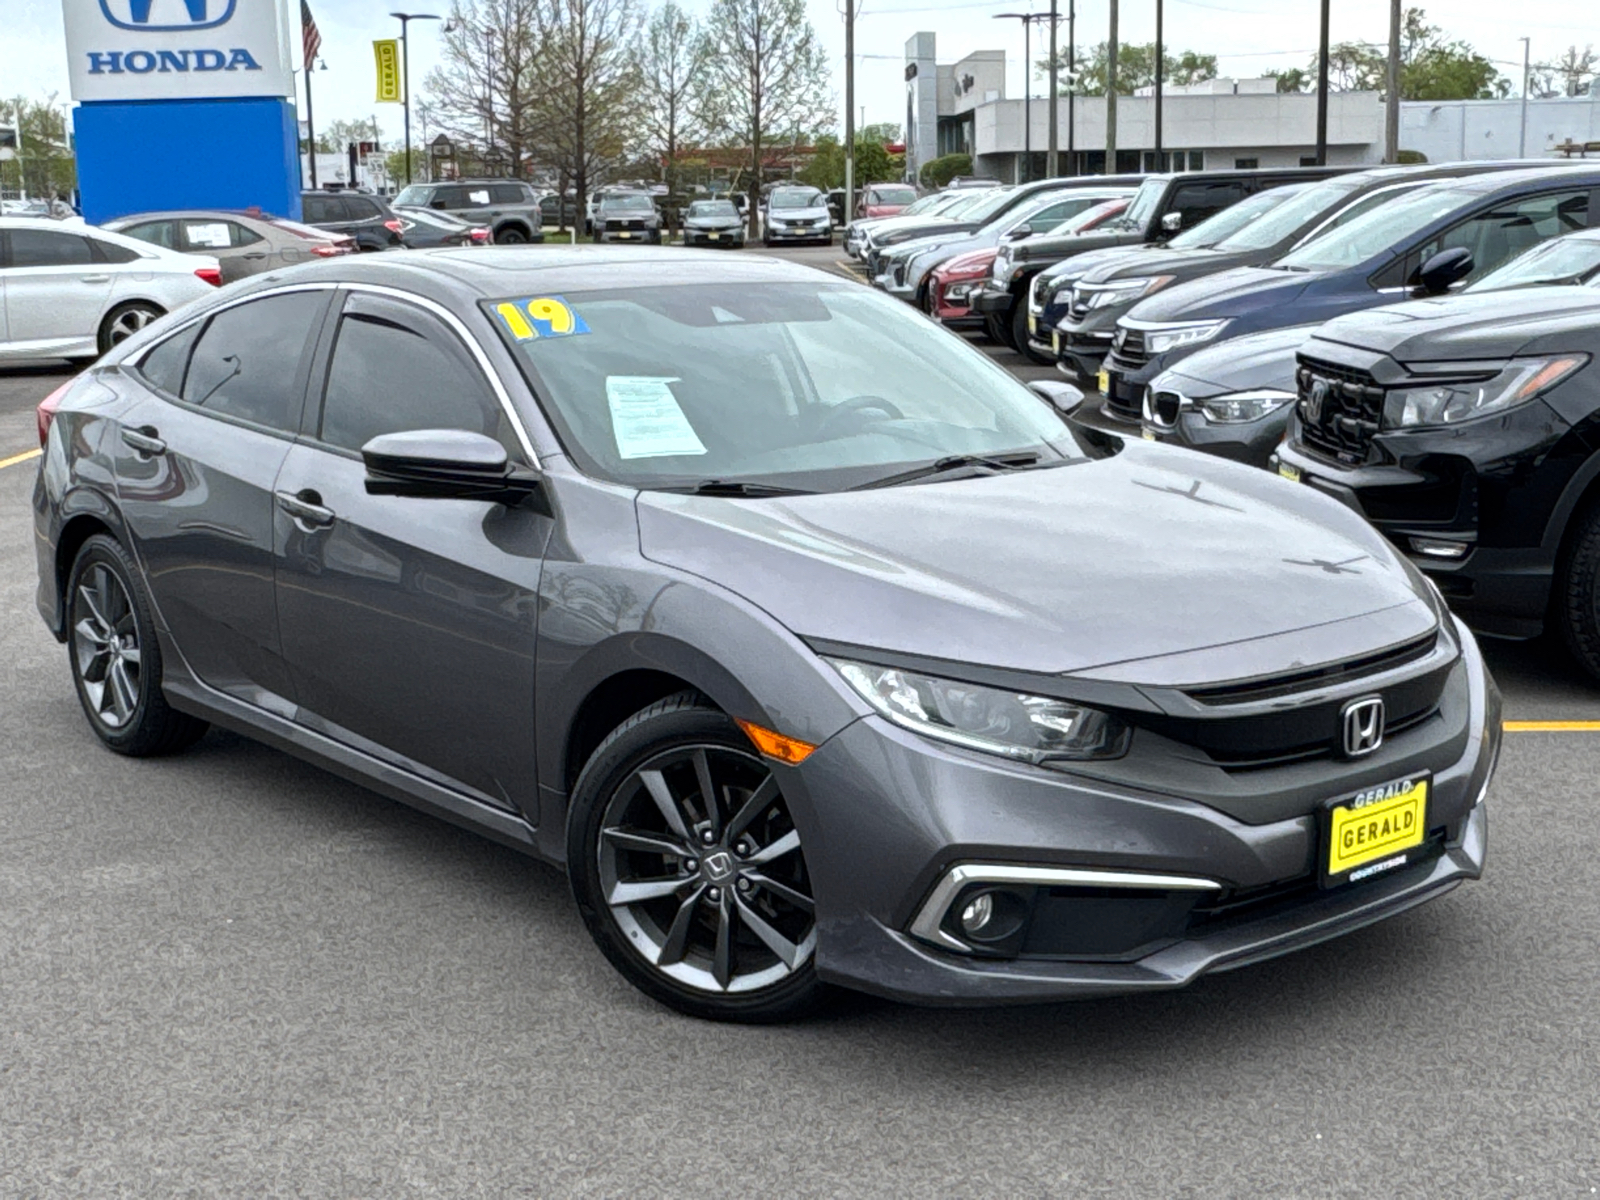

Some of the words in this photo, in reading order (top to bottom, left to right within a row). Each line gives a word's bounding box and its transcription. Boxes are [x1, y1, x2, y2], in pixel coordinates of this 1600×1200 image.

[87, 49, 262, 74] HONDA
[383, 47, 393, 95] GERALD
[497, 298, 573, 339] 19
[1354, 780, 1412, 809] GERALD
[1343, 810, 1413, 849] GERALD
